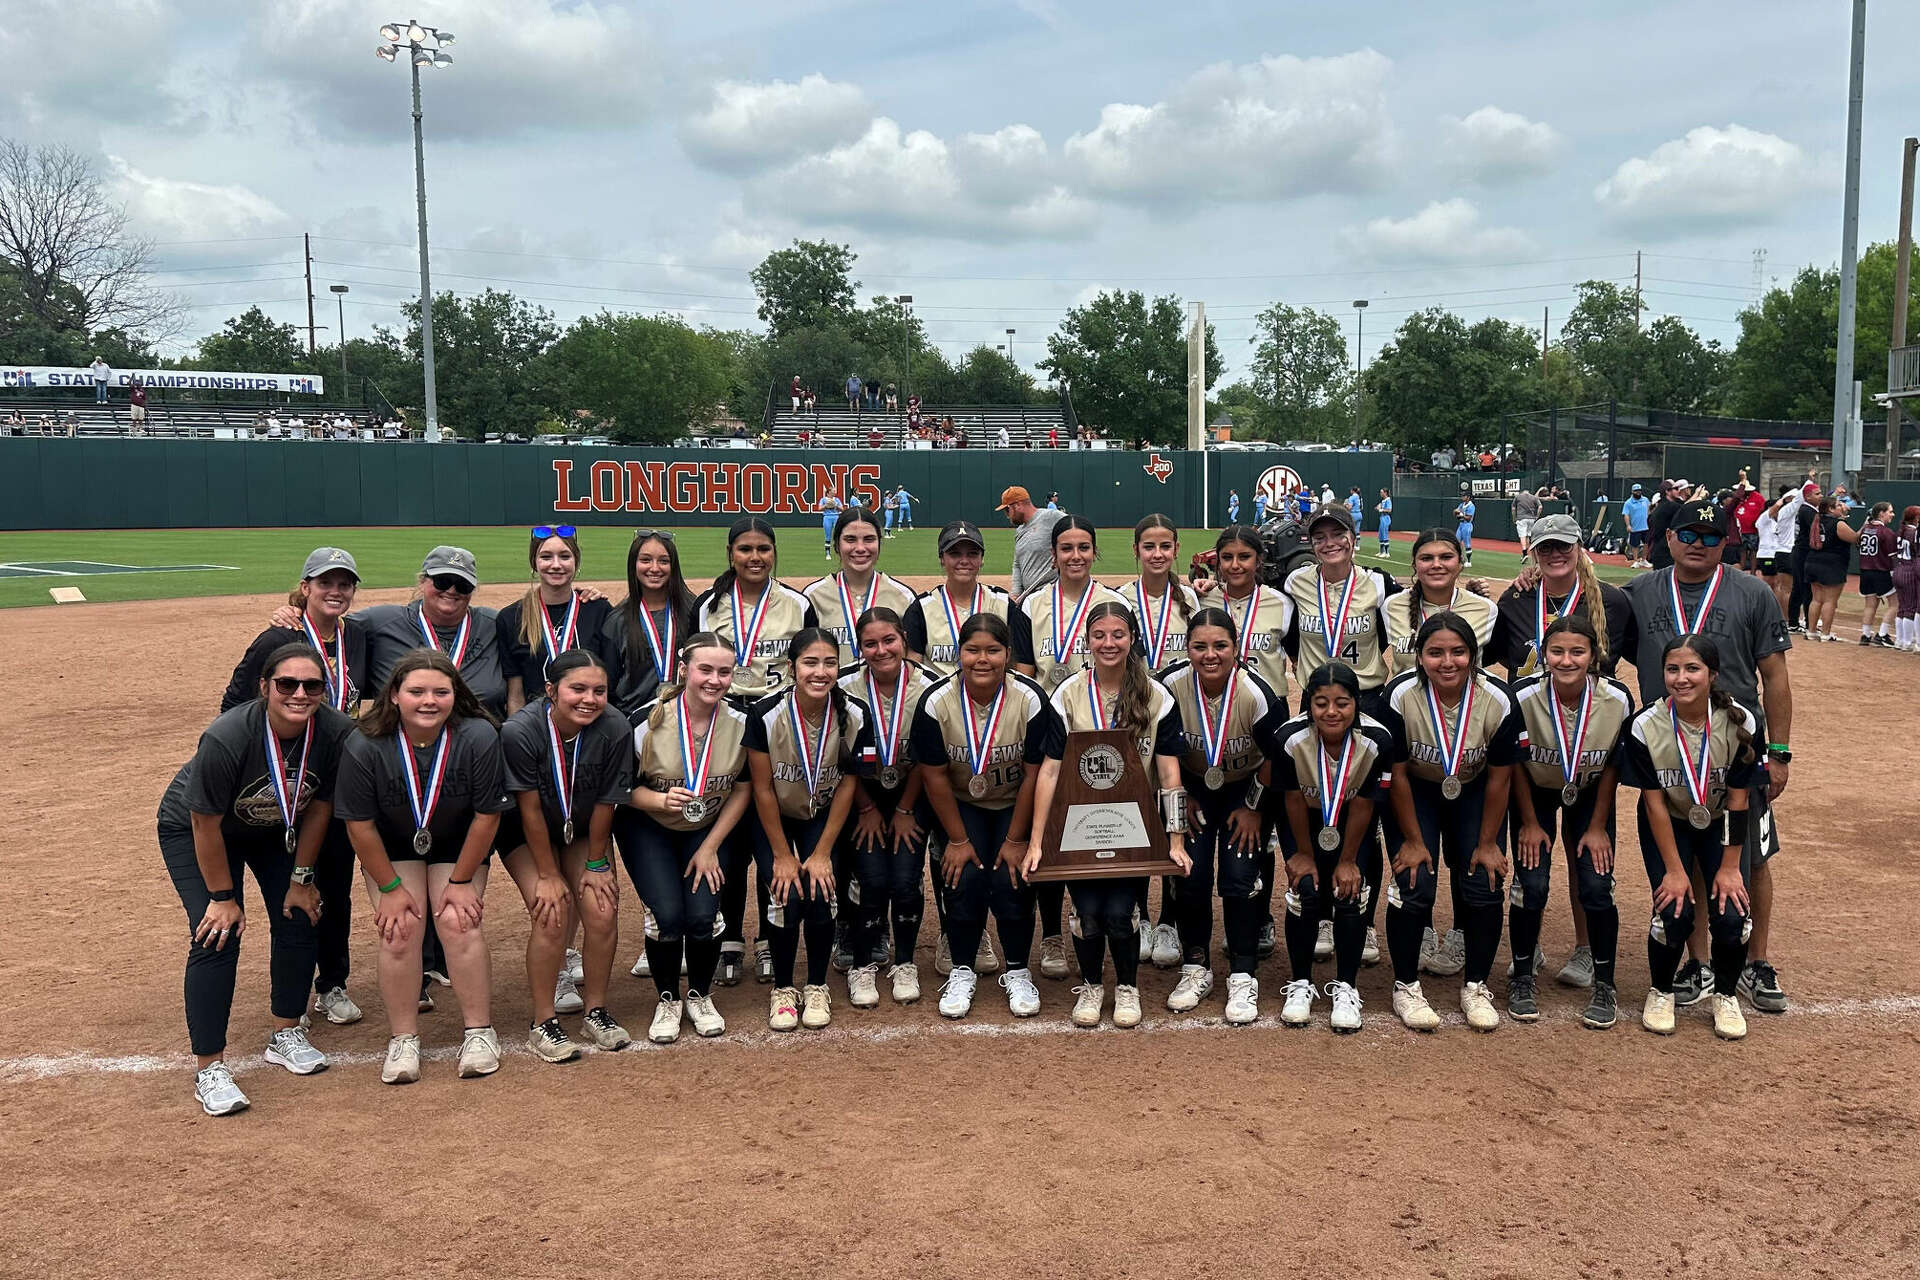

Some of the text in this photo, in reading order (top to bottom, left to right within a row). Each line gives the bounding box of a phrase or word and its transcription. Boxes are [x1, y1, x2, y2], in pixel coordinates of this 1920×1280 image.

[48, 373, 95, 386] STAT
[1153, 463, 1170, 472] 200
[553, 459, 881, 514] LONGHORNS
[1473, 482, 1493, 491] TEXAS
[1860, 534, 1878, 556] 29
[1341, 639, 1360, 665] 4
[766, 662, 783, 689] 5
